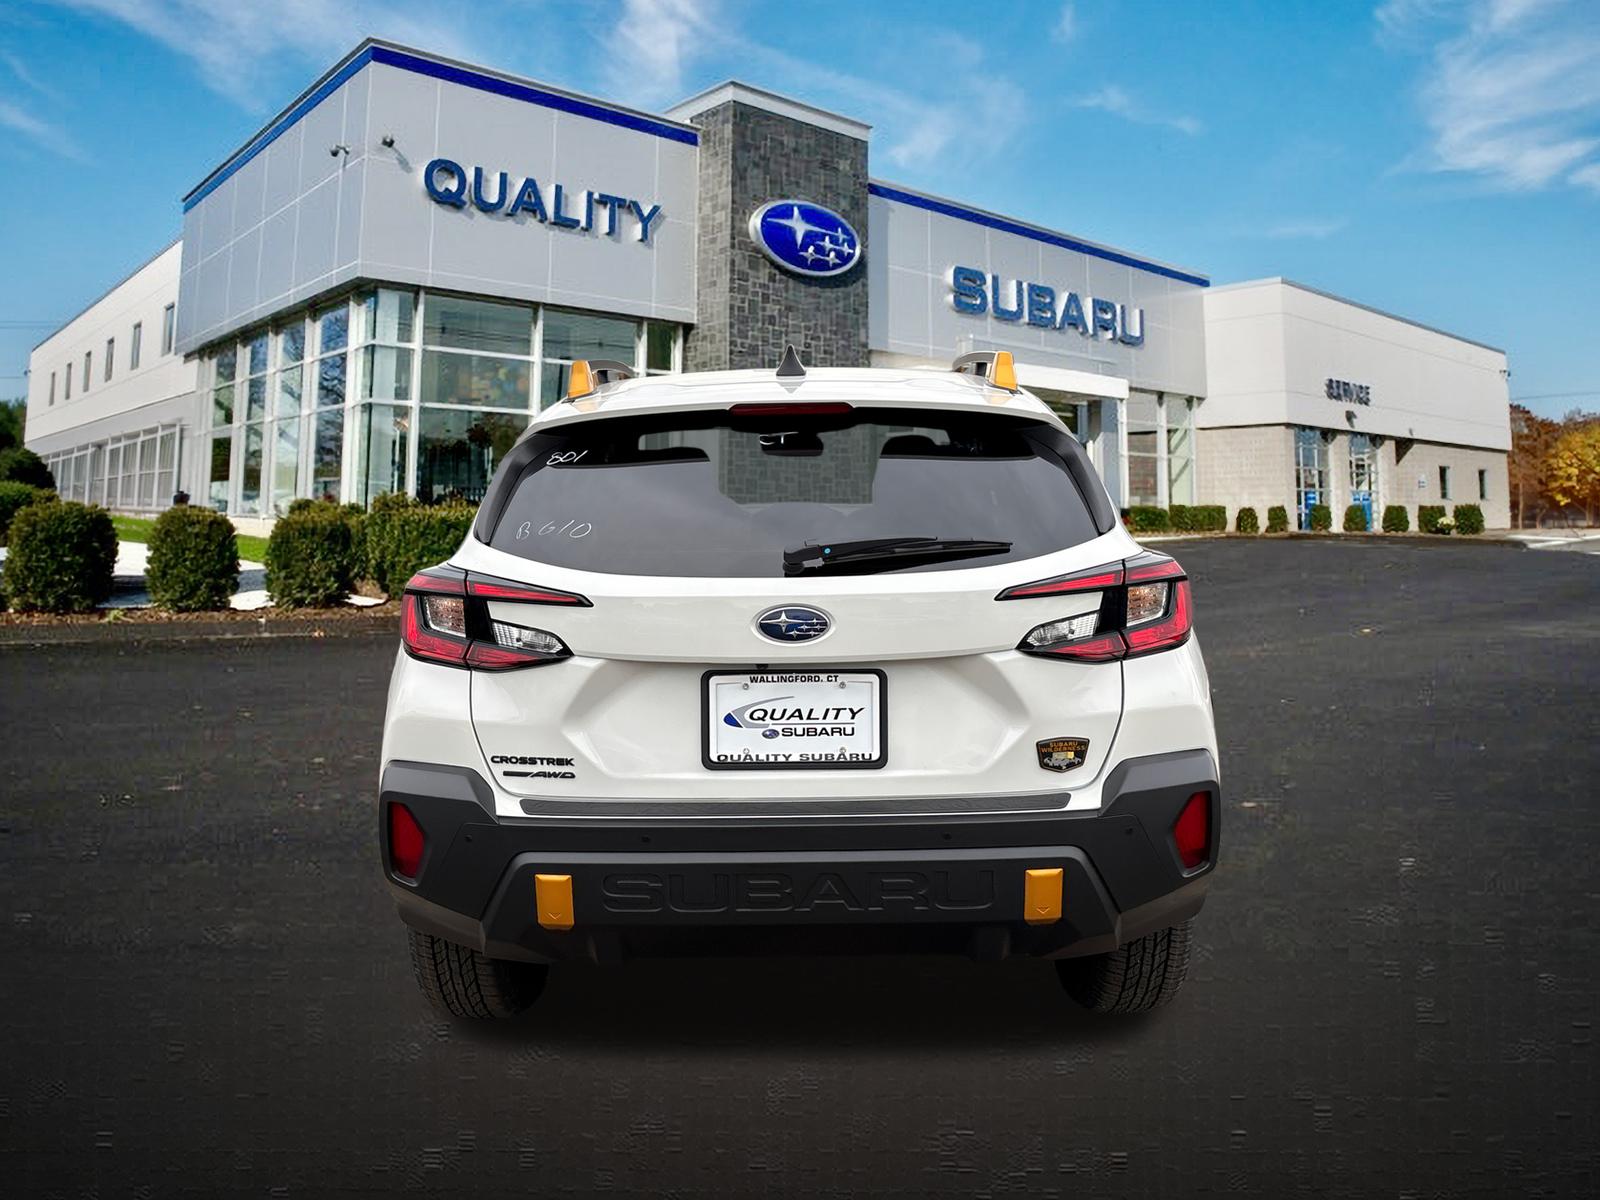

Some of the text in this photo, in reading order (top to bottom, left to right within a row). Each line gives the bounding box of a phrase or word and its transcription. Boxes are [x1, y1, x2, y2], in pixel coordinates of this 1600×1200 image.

[424, 158, 661, 243] QUALITY
[951, 265, 1145, 347] SUBARU
[1325, 378, 1371, 407] SERVICE
[826, 675, 839, 683] CT
[749, 707, 865, 722] QUALITY
[781, 727, 855, 737] SUBARU
[490, 755, 576, 767] CROSSTREK
[716, 752, 873, 762] QUALITY SUBARU
[529, 771, 576, 779] AWD
[601, 871, 996, 913] SUBARU
